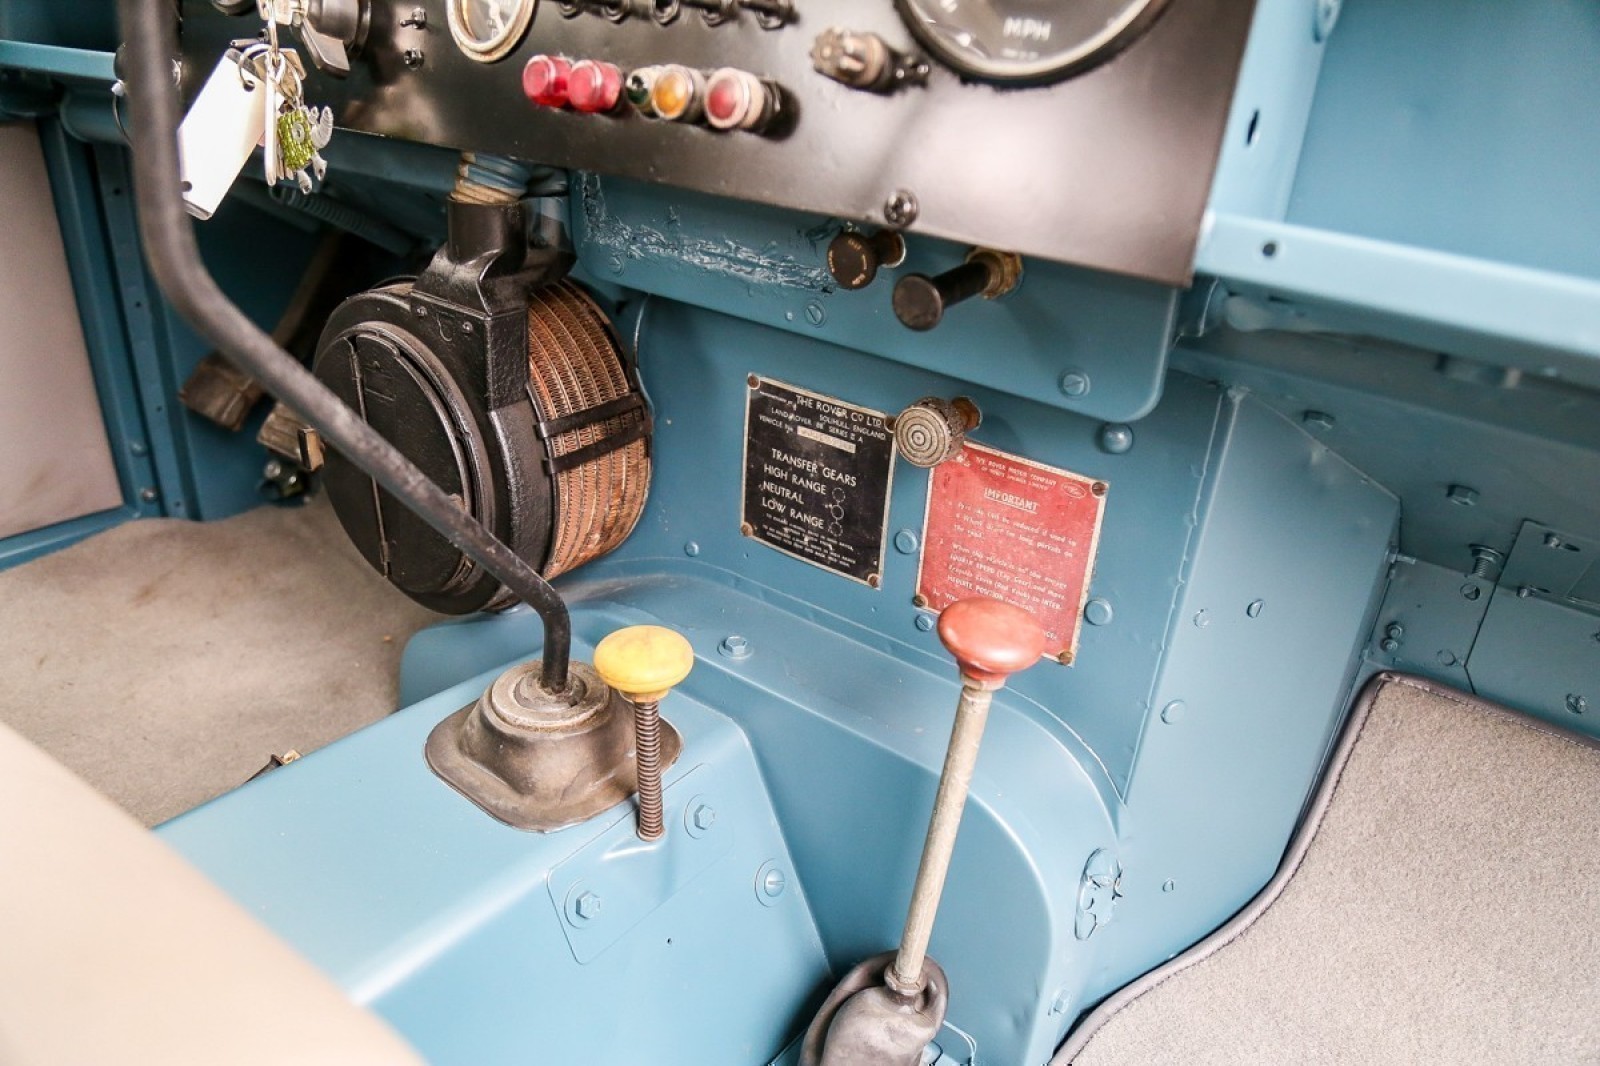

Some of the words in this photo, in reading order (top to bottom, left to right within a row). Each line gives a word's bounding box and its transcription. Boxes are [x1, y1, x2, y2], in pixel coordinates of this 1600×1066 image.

[1003, 15, 1052, 41] MPH
[771, 407, 788, 417] LAND
[796, 395, 813, 407] THE
[816, 401, 848, 418] ROVER
[866, 416, 881, 427] LTD
[853, 424, 886, 440] ENGLAND
[764, 463, 788, 479] HIGH
[792, 474, 827, 494] RANGE
[772, 448, 818, 473] TRANSFER
[823, 466, 857, 487] GEARS
[763, 480, 805, 504] NEUTRAL
[984, 487, 1038, 511] IMPORTANT
[763, 496, 786, 513] LOW
[790, 508, 824, 529] RANGE
